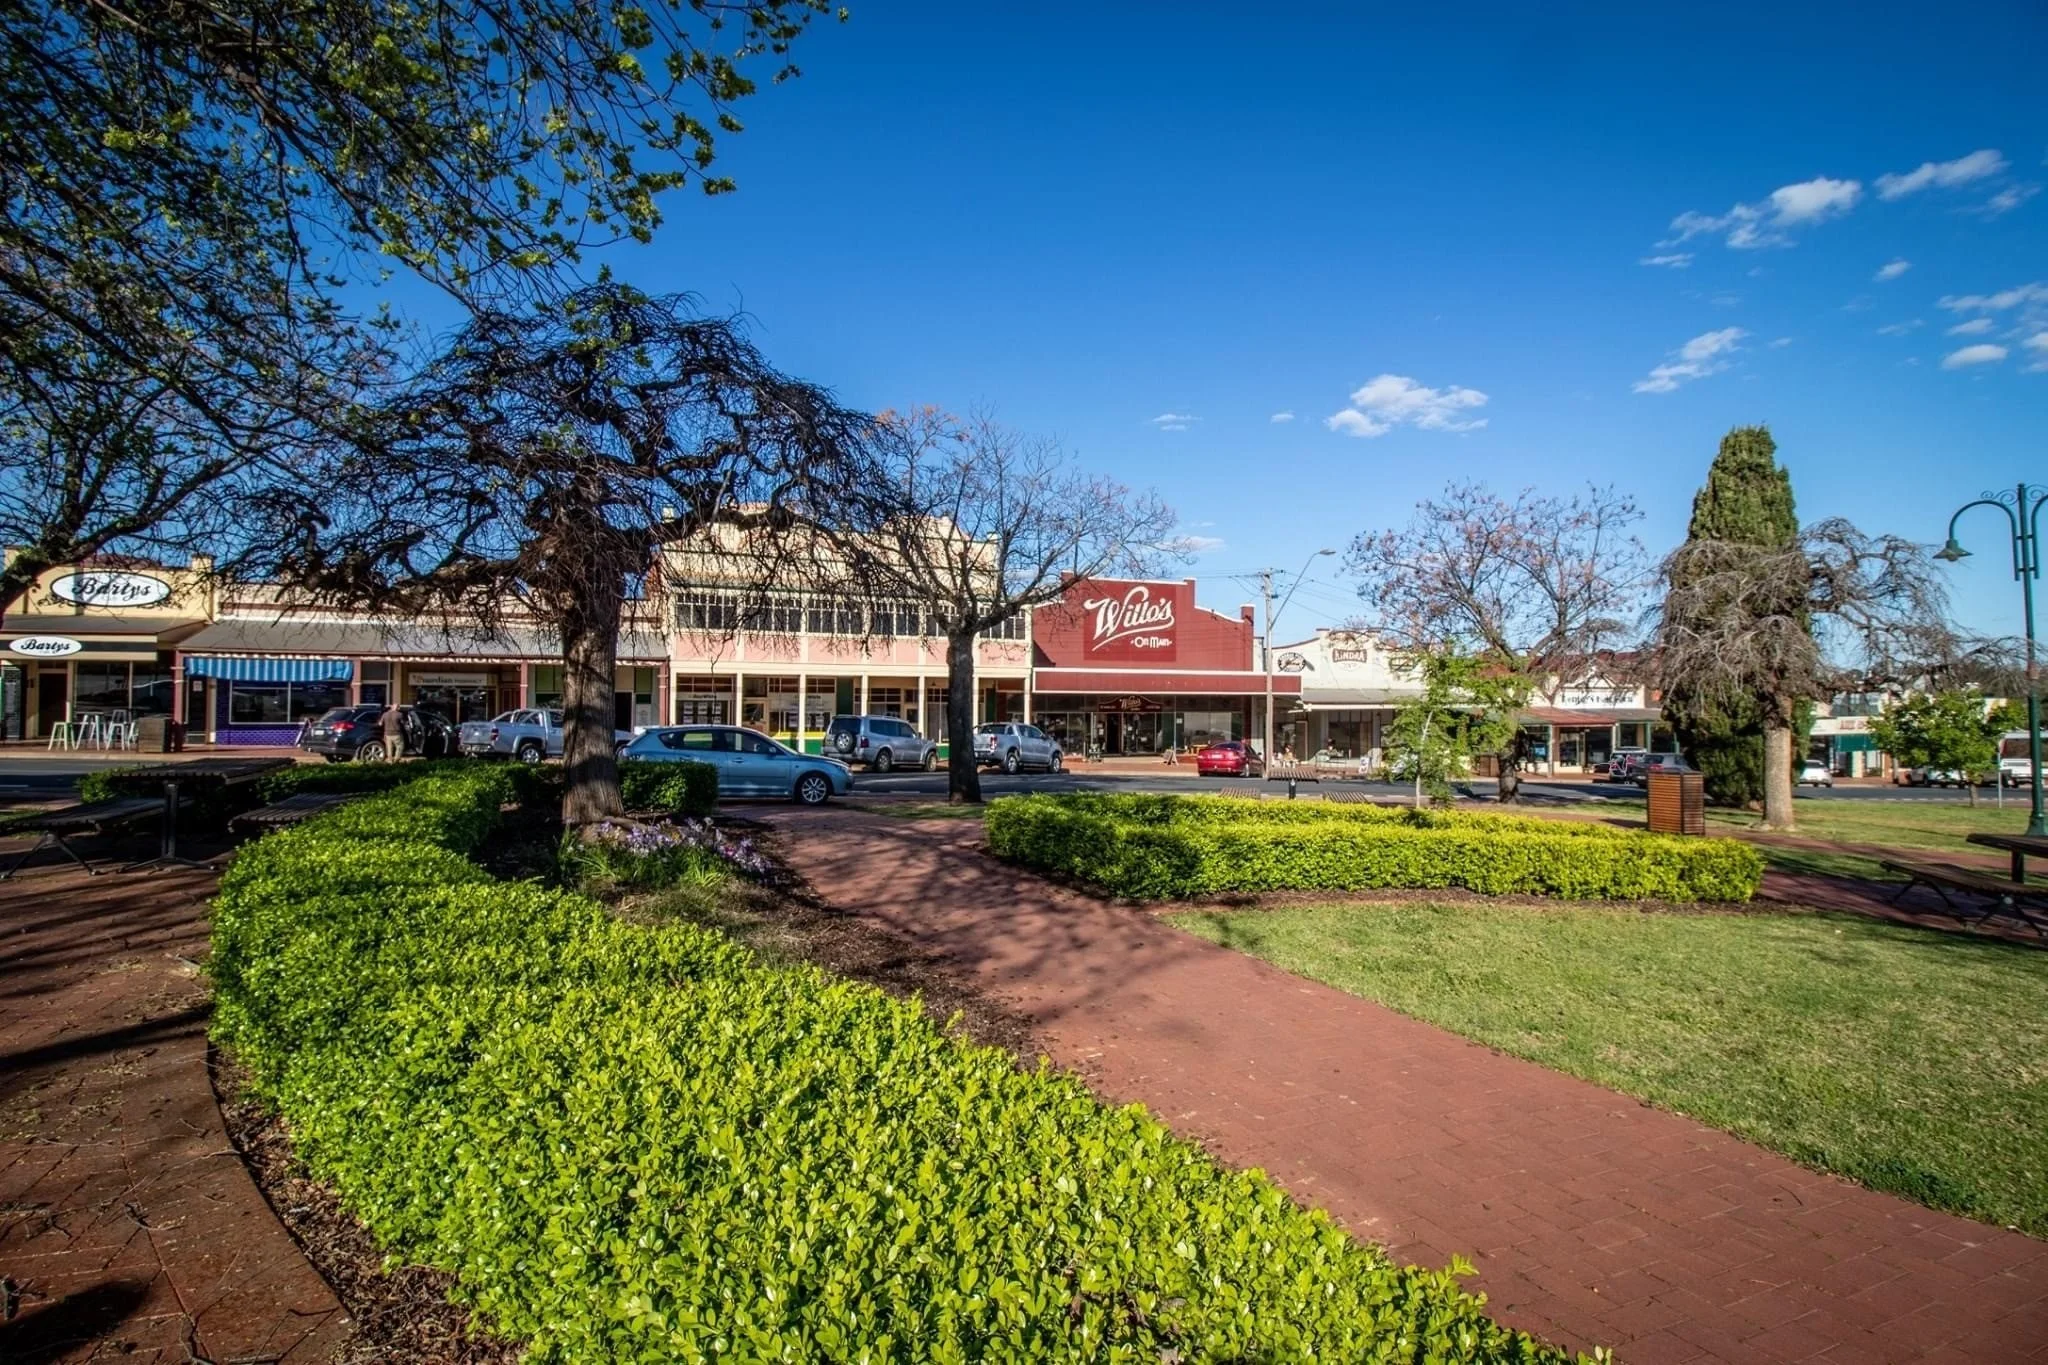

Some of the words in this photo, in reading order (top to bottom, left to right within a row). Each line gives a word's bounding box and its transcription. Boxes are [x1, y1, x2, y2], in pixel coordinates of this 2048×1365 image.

[72, 577, 150, 600] Bartys
[1083, 586, 1175, 651] Willo's
[21, 638, 70, 653] Bartys
